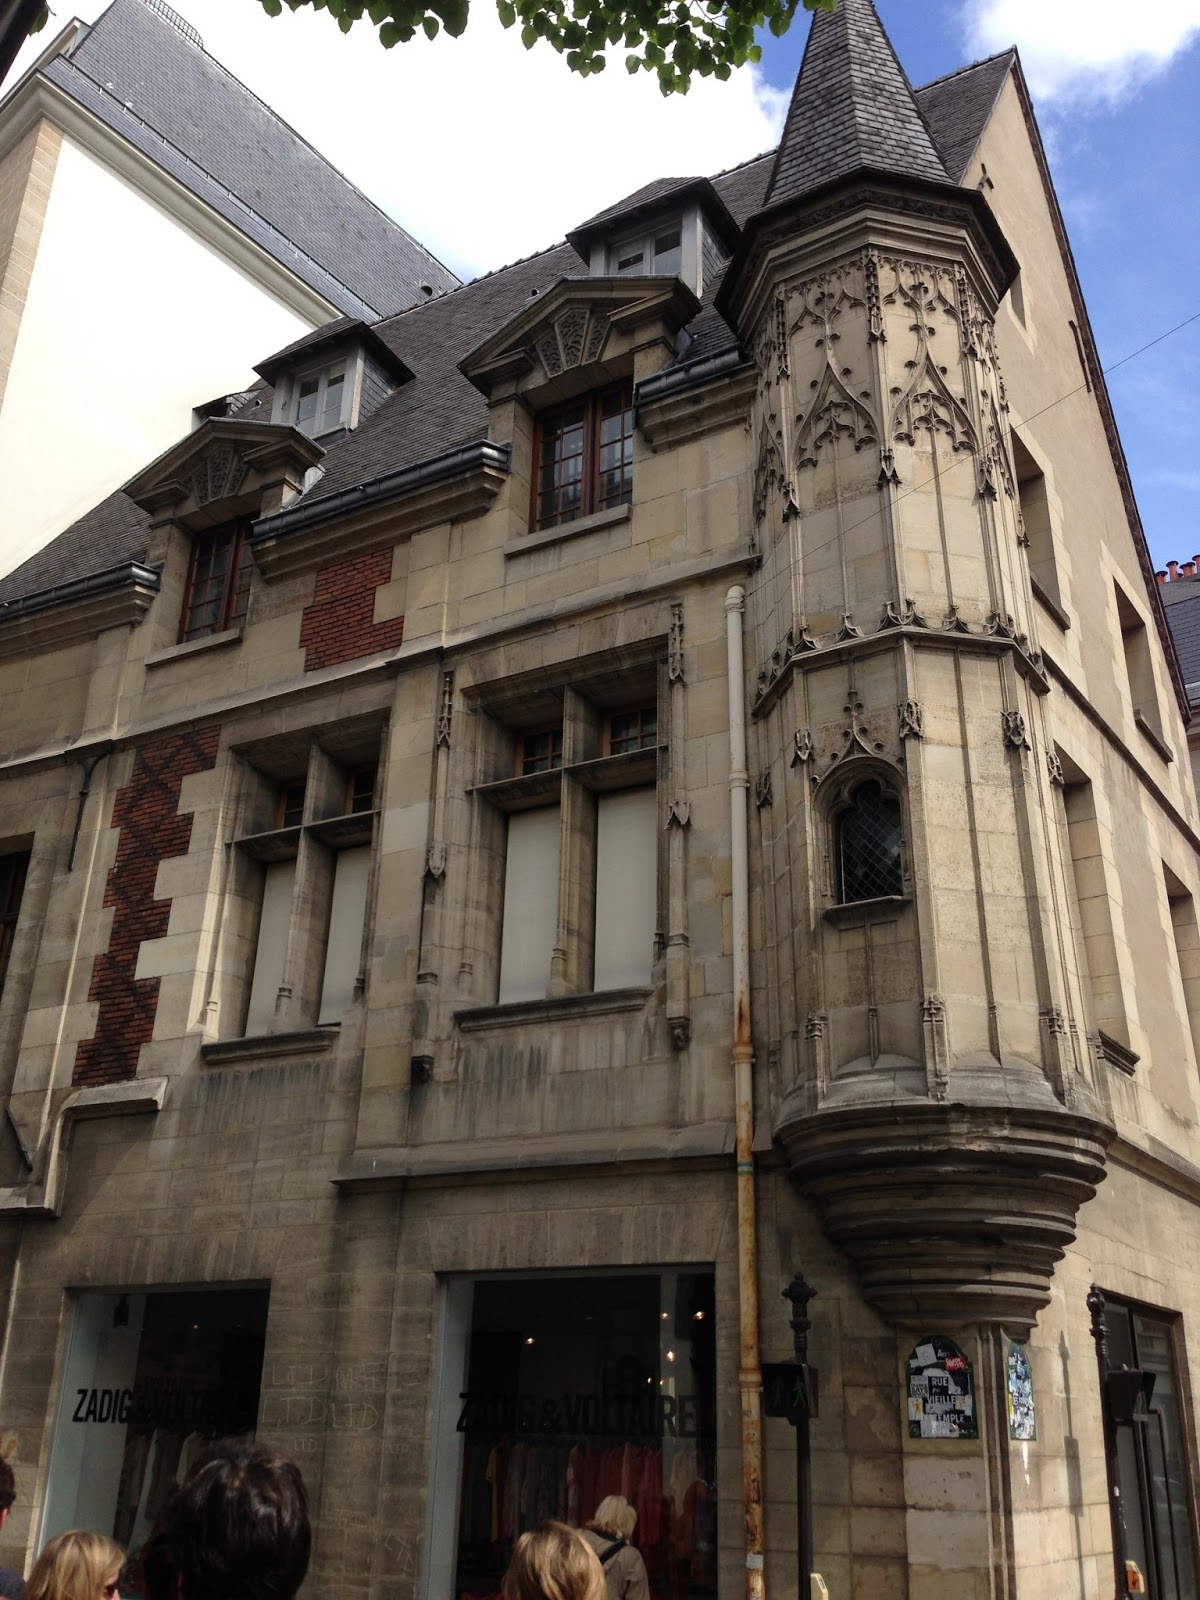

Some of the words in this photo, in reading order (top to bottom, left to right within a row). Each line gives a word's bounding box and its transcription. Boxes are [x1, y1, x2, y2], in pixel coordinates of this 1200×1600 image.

[931, 1377, 948, 1387] RUE
[927, 1395, 957, 1405] VIEILLE
[931, 1413, 965, 1423] EMPLE
